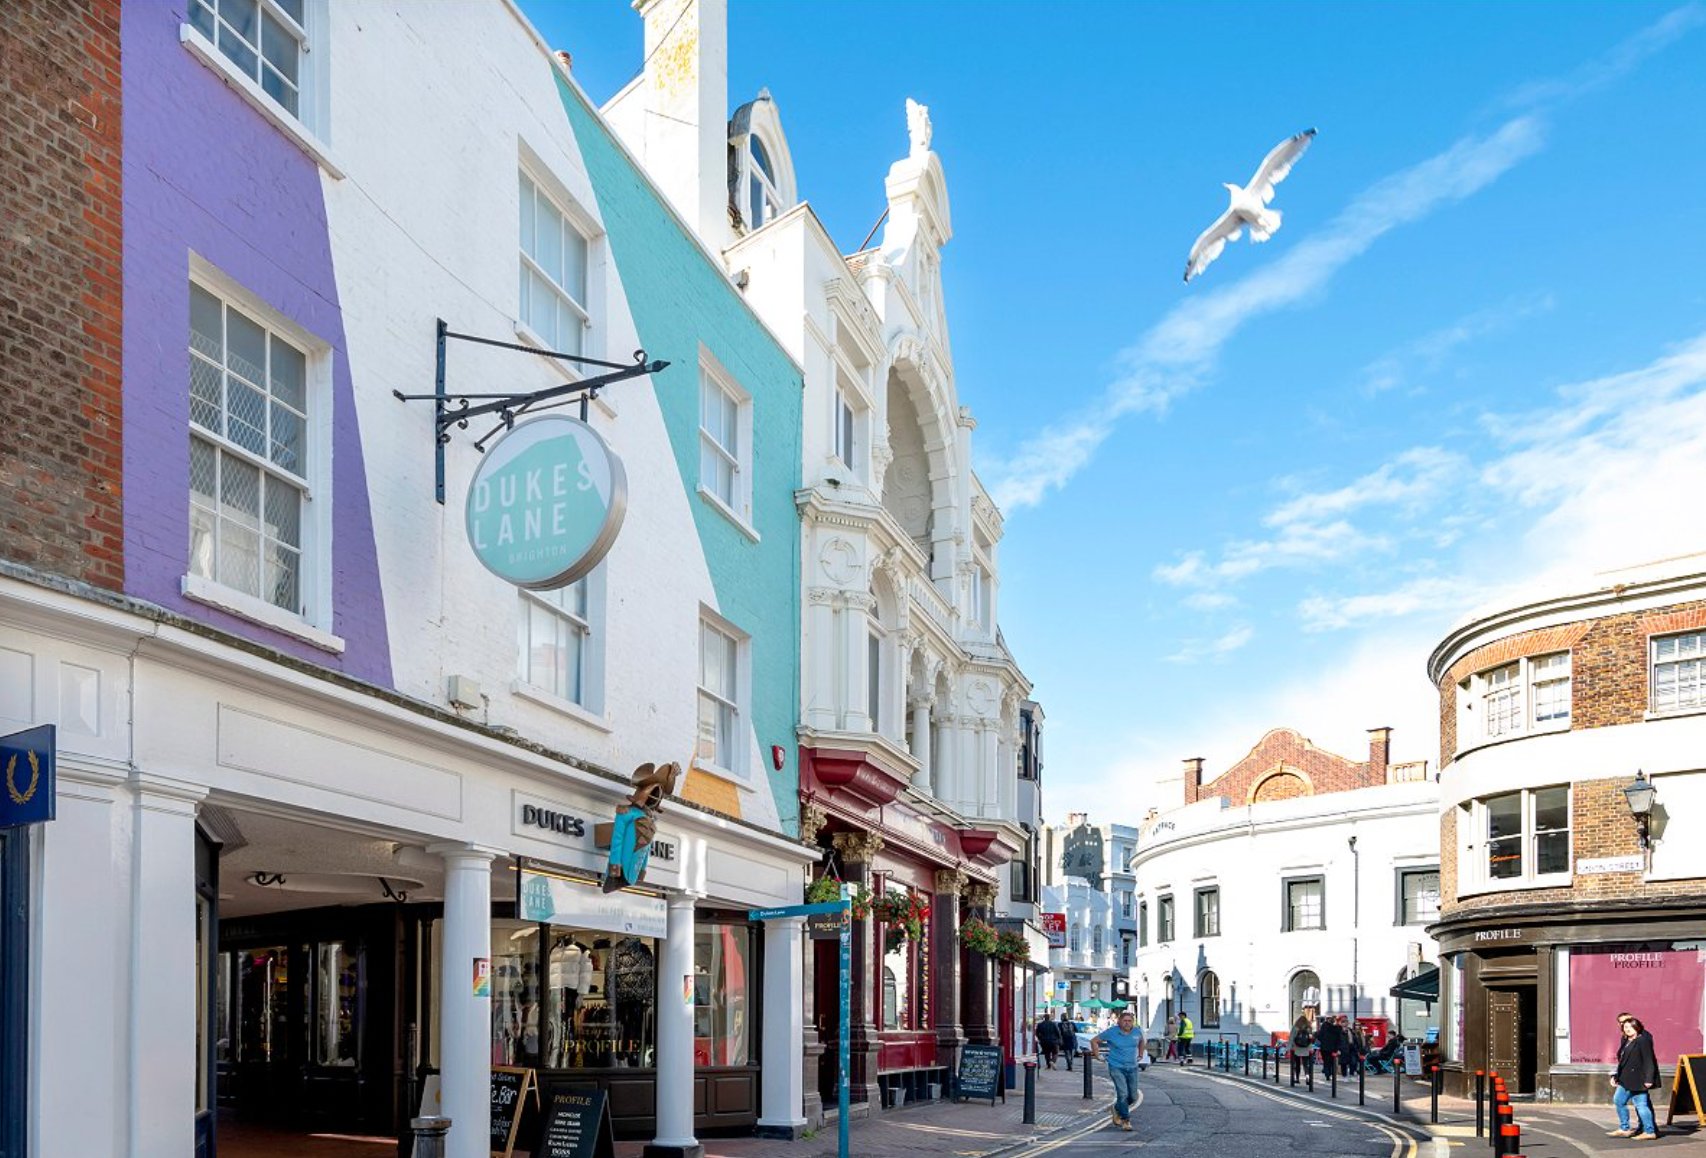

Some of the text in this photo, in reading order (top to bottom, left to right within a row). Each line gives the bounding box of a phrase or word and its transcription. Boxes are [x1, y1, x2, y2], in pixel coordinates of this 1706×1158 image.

[474, 459, 594, 513] DUKES
[473, 502, 567, 550] LANE
[509, 544, 568, 565] BRIGHTON
[523, 804, 675, 861] DUKES ANE
[523, 882, 552, 897] DUKES
[522, 895, 546, 910] LANE
[1475, 928, 1521, 942] PROFILE
[1610, 952, 1663, 962] PROFILE
[564, 1039, 640, 1054] PROFILE
[553, 1094, 592, 1106] PROFILE
